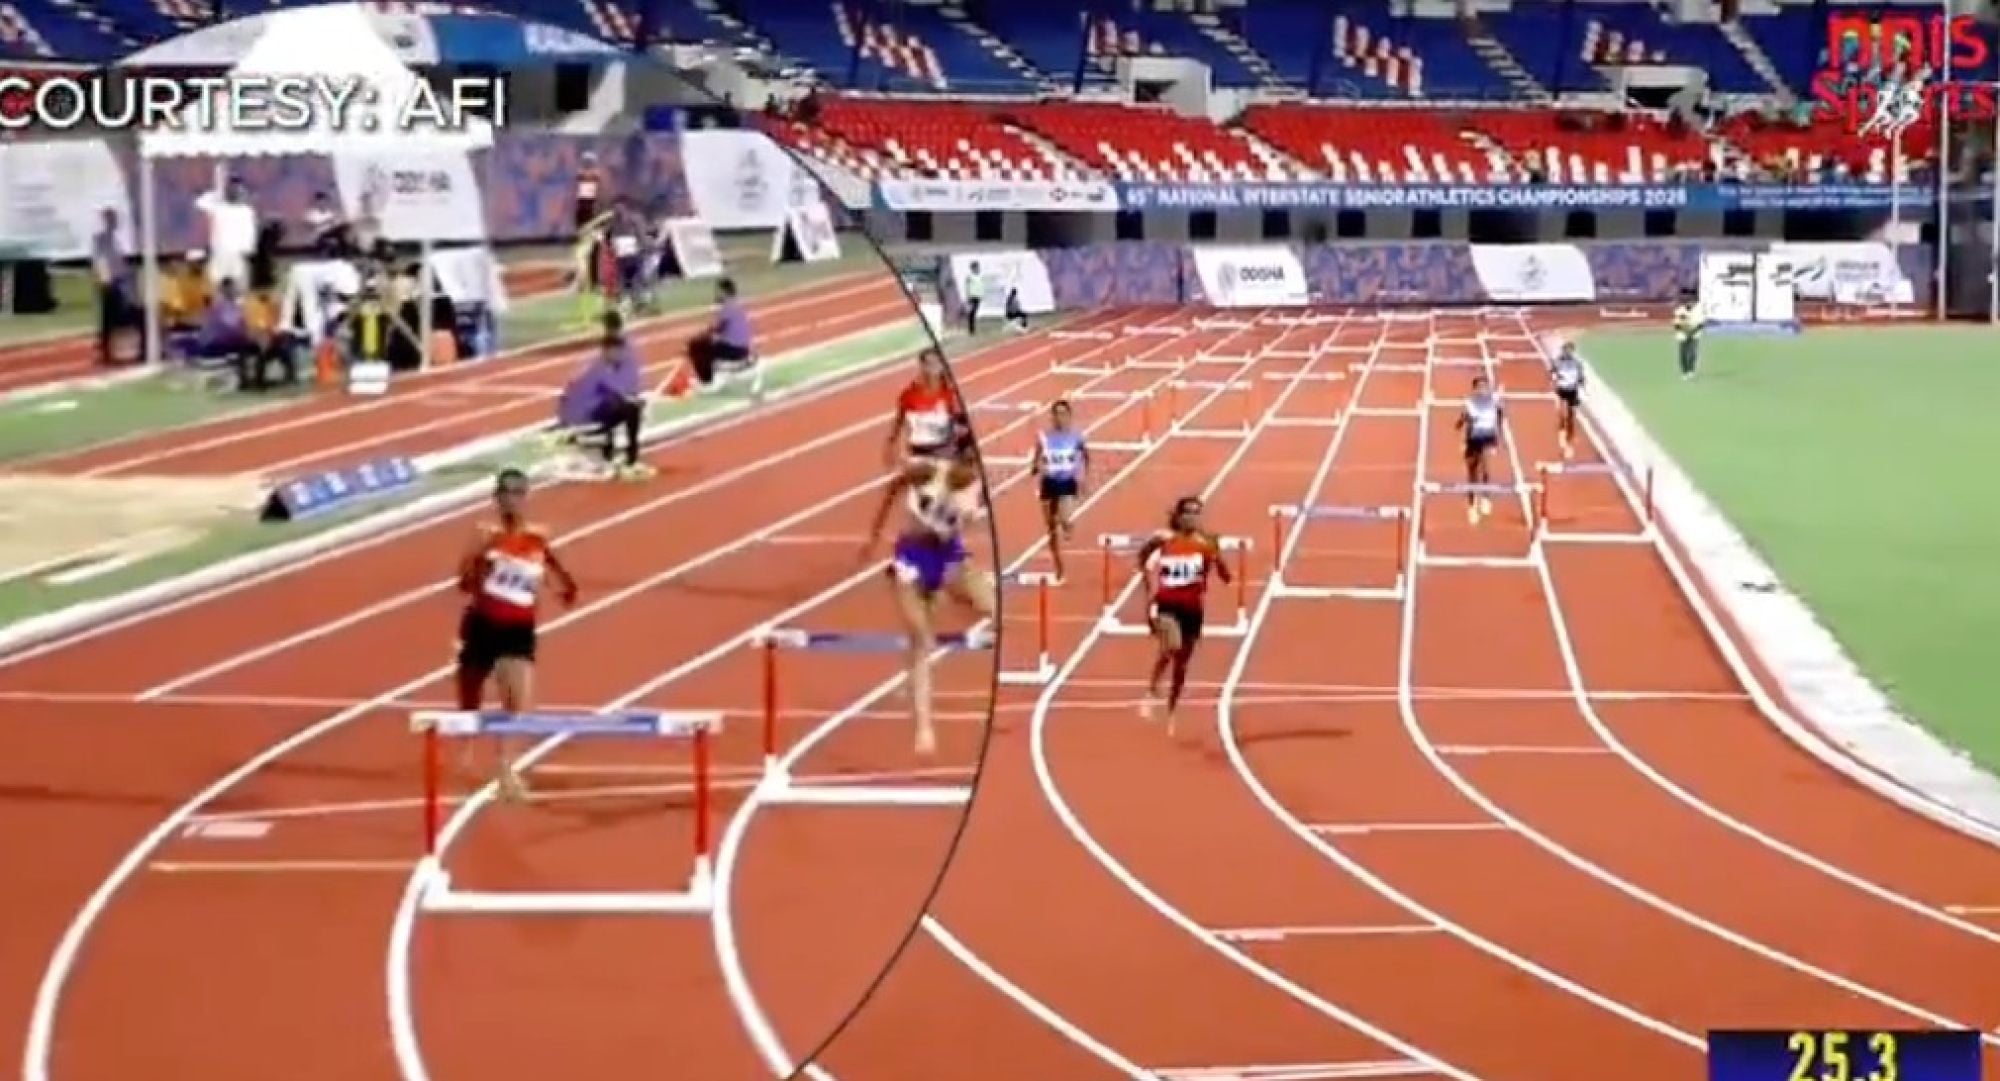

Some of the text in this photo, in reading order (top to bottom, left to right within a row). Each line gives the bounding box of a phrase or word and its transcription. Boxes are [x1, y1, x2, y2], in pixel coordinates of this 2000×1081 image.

[1157, 187, 1240, 206] NATIONAL
[1405, 187, 1495, 206] ATHLETICS
[1497, 187, 1640, 206] CHAMPIONSHIPS
